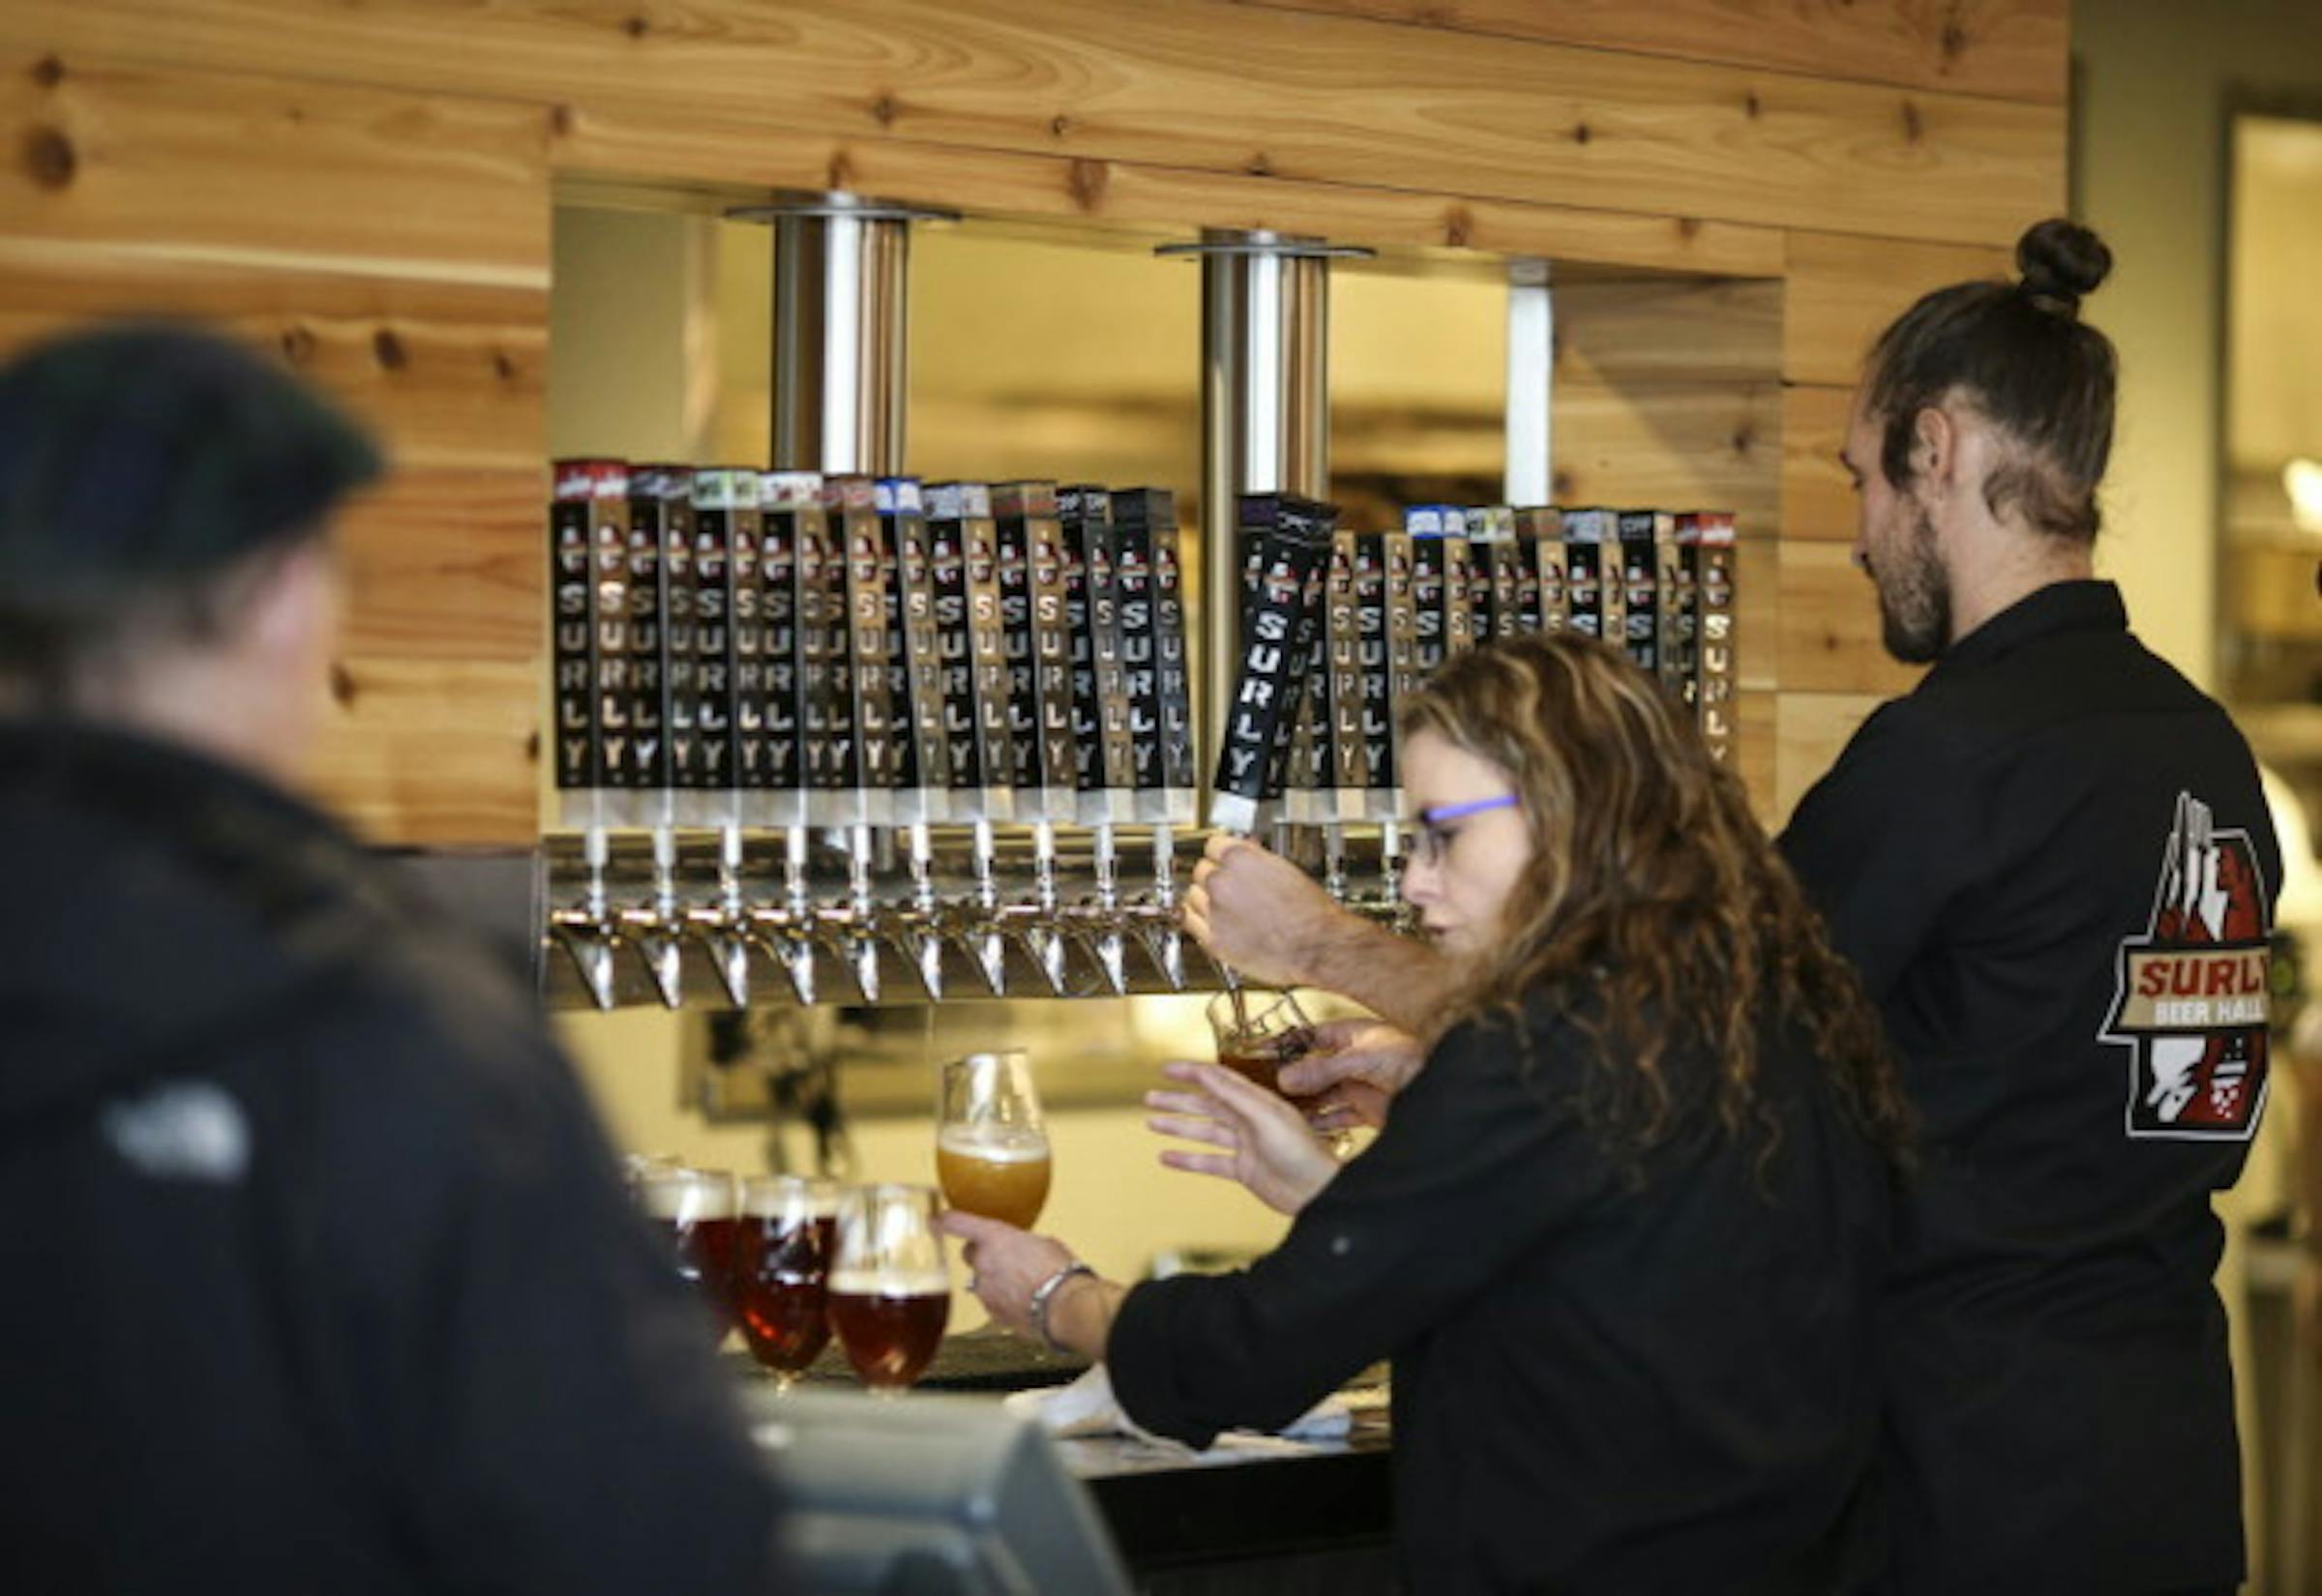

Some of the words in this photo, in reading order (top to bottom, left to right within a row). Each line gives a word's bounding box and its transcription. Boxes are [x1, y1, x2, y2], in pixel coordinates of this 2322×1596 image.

[559, 584, 586, 769] SURLY
[599, 581, 625, 769] SURLY
[631, 586, 657, 768] SURLY
[697, 587, 726, 770] SURLY
[736, 587, 760, 769] SURLY
[764, 587, 793, 770] SURLY
[858, 592, 884, 768] SURLY
[938, 596, 970, 767] SURLY
[1001, 596, 1032, 769] SURLY
[1038, 597, 1065, 767] SURLY
[1067, 601, 1096, 770] SURLY
[1122, 601, 1154, 770] SURLY
[1160, 602, 1184, 767] SURLY
[1230, 611, 1288, 776] SURLY
[1332, 606, 1355, 769] SURLY
[1357, 606, 1385, 772] SURLY
[2155, 1001, 2208, 1026] BEER
